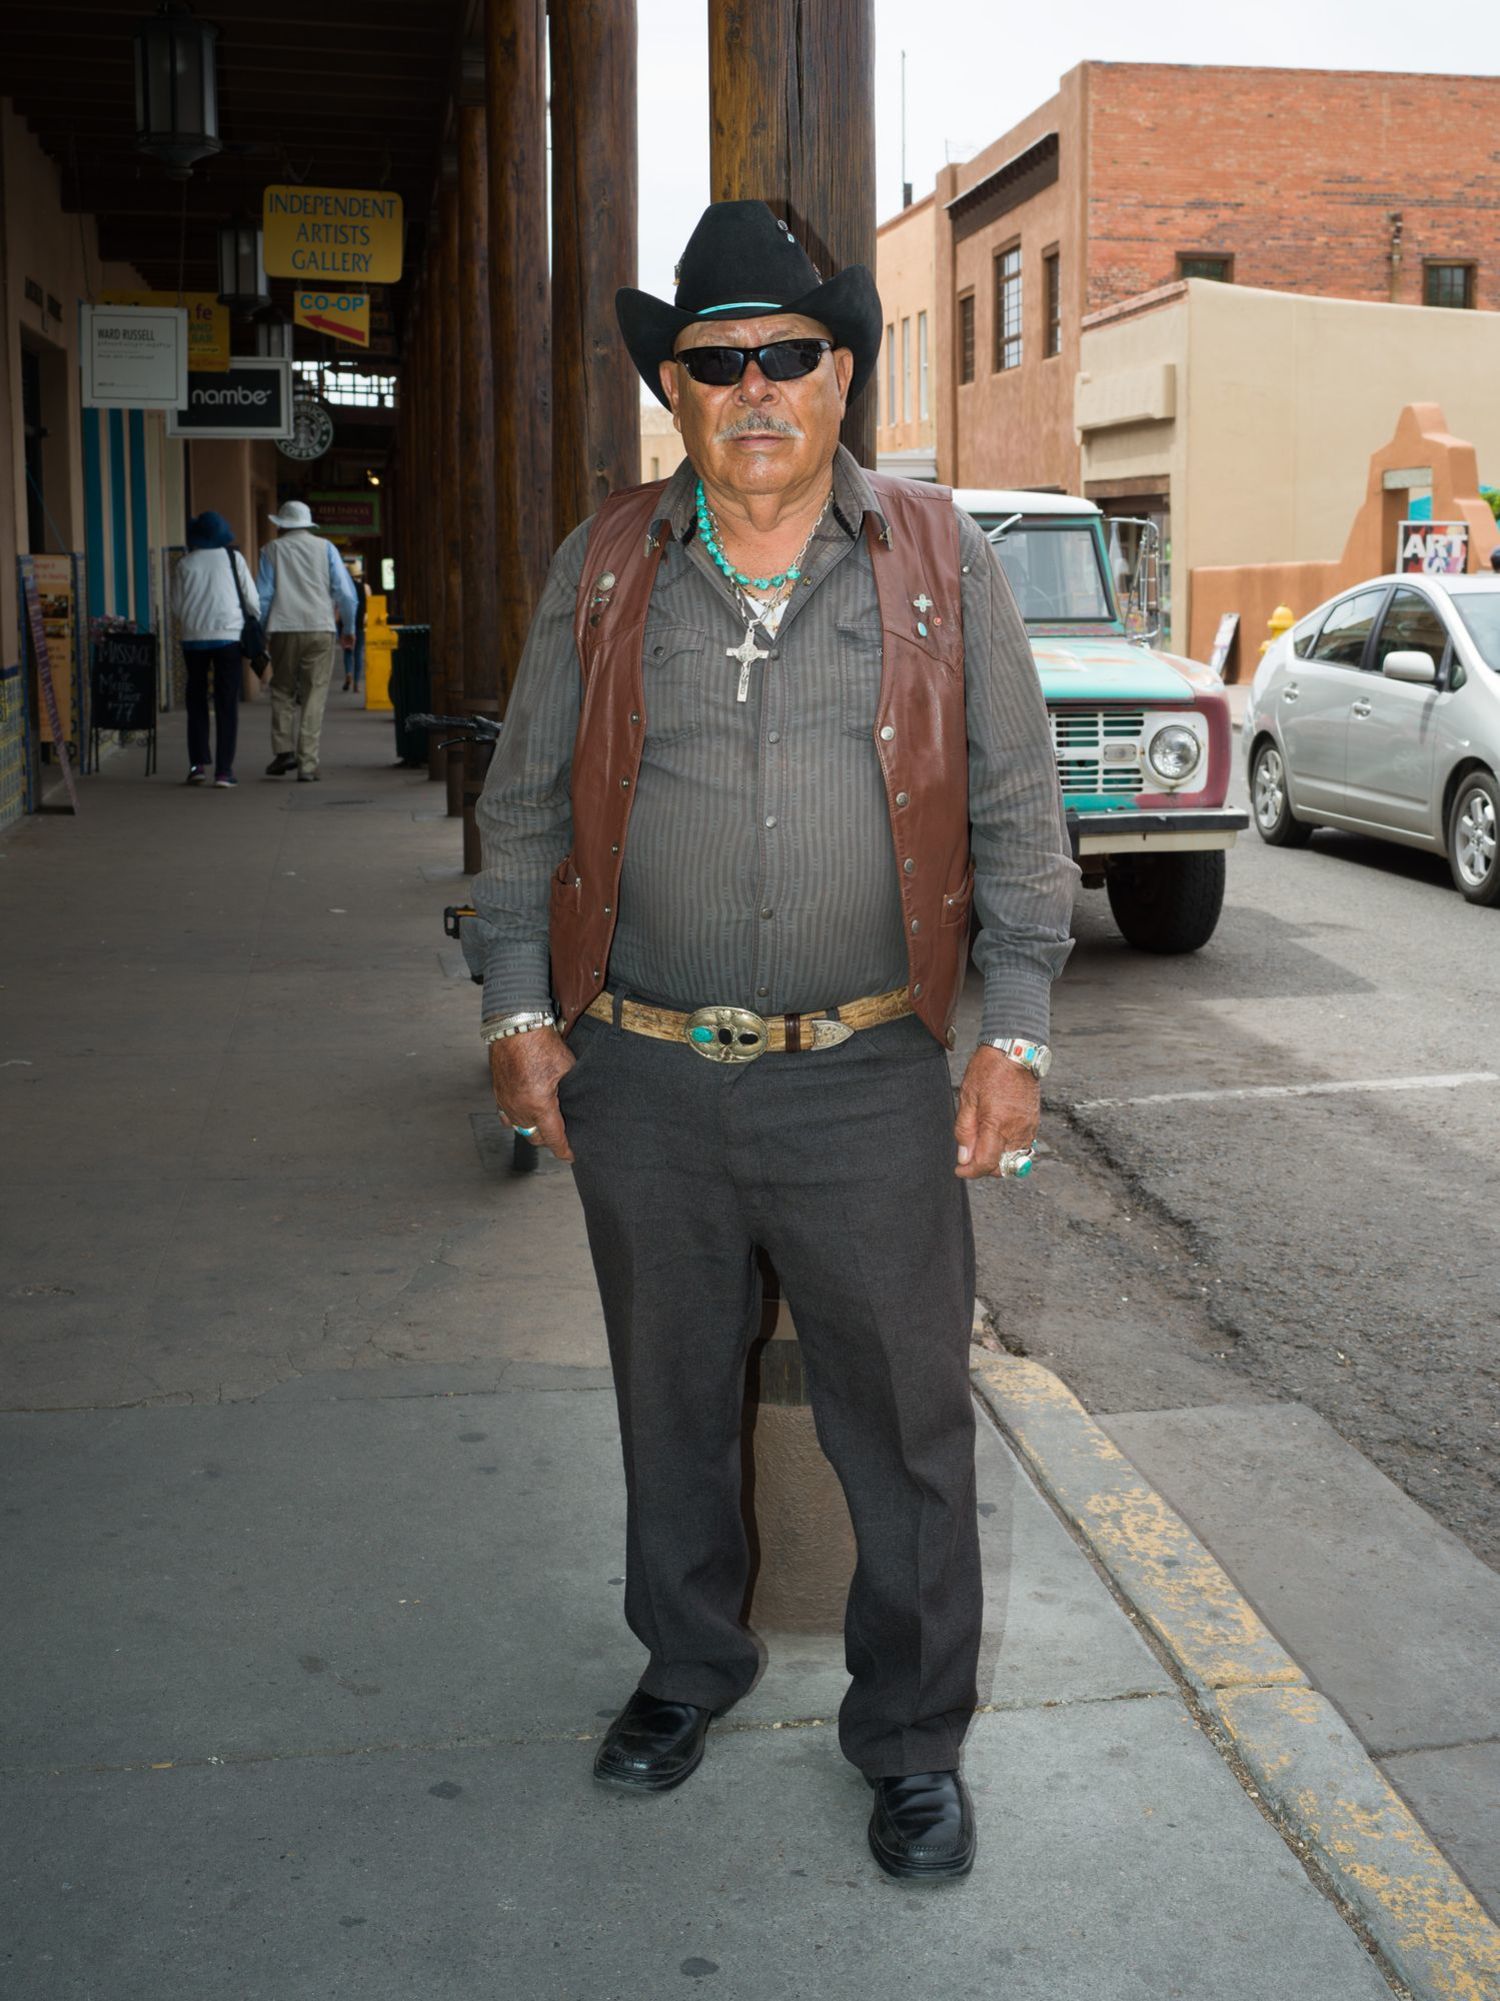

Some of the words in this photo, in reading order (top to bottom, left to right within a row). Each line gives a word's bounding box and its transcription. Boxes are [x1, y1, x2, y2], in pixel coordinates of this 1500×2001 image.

[269, 192, 397, 219] INDEPENDENT
[296, 223, 370, 246] ARTISTS
[291, 249, 373, 272] GALLERY
[300, 294, 365, 311] CO-OP
[97, 327, 121, 340] WARD
[122, 328, 155, 341] RUSSELL
[280, 441, 322, 458] COFFEE
[1403, 533, 1469, 558] ART
